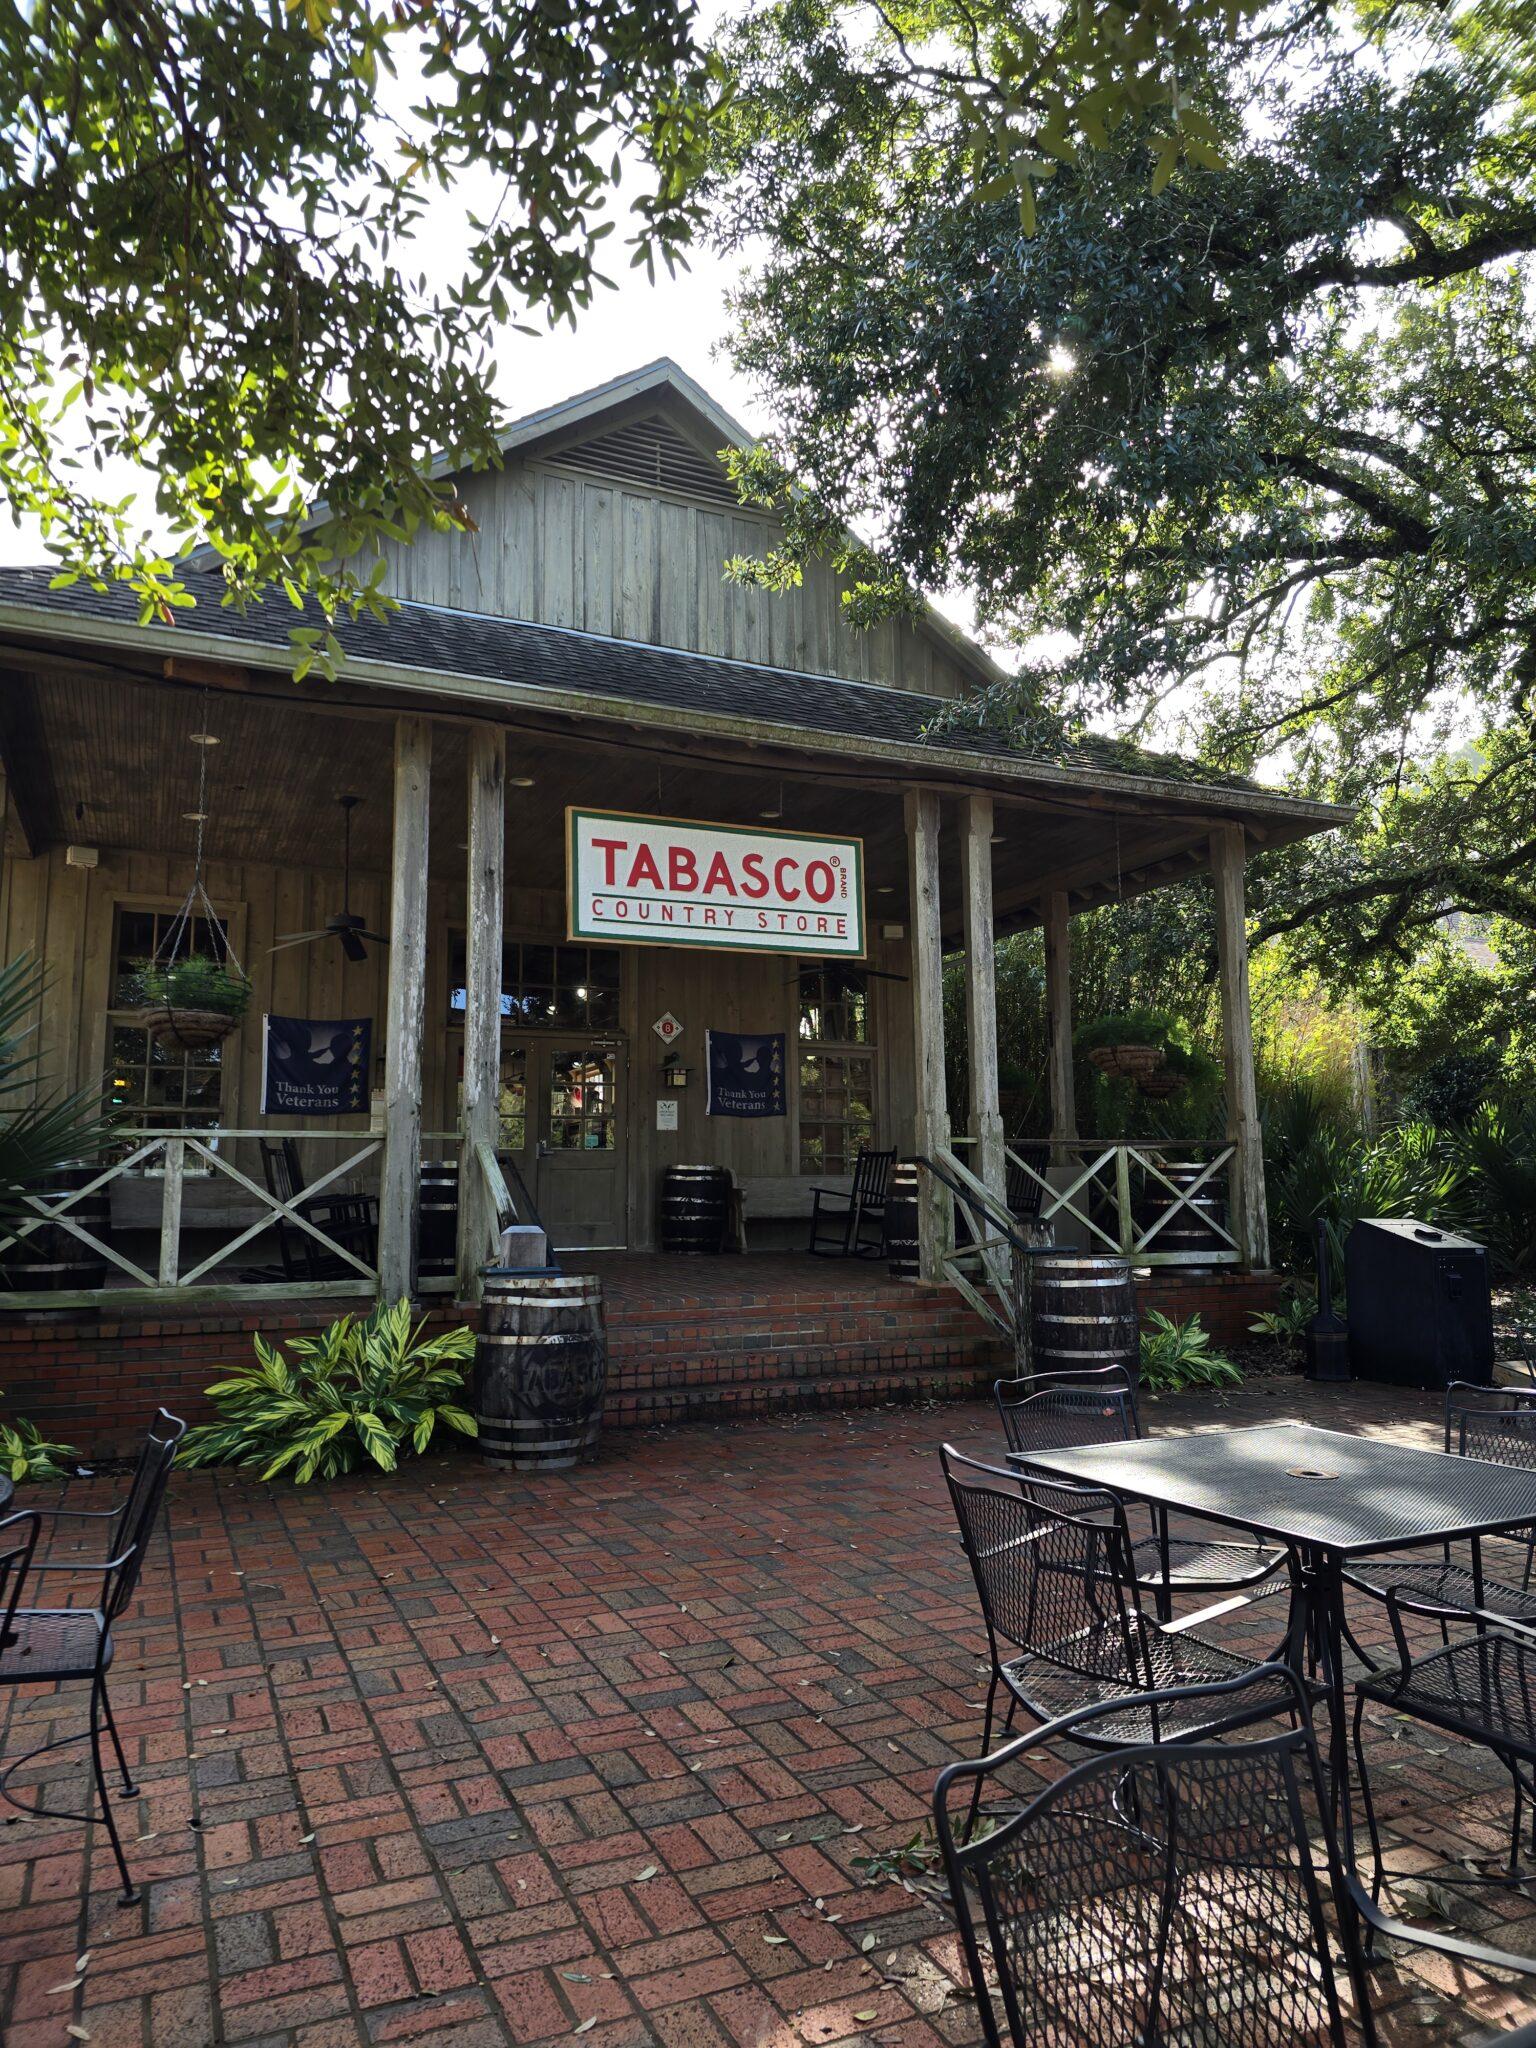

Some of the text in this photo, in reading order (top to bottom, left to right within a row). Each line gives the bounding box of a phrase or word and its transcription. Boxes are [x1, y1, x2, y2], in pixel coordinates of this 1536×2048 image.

[592, 838, 835, 904] TABASCO
[839, 867, 848, 899] BRAND
[592, 898, 846, 934] COUNTRY STORE
[276, 1081, 339, 1095] Thank You
[718, 1087, 766, 1099] Thank You
[276, 1093, 339, 1107] Veterans
[718, 1098, 766, 1110] Veterans
